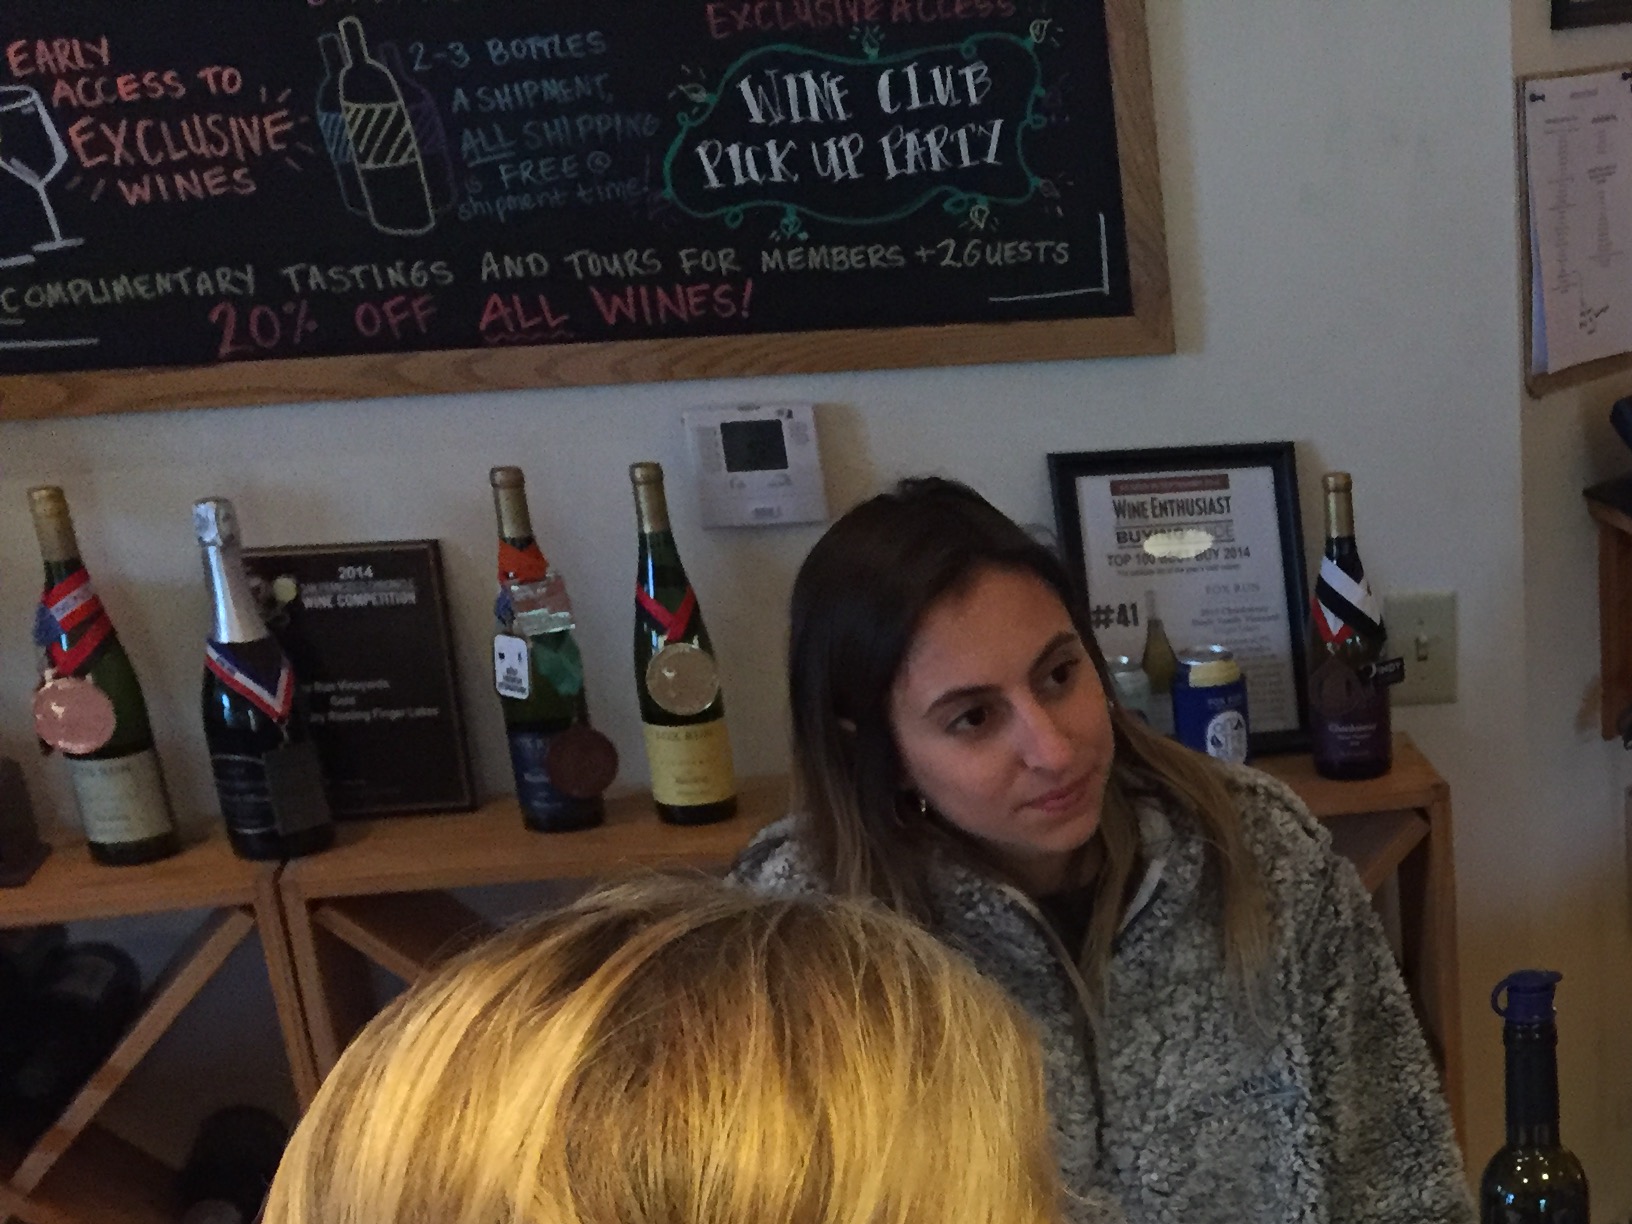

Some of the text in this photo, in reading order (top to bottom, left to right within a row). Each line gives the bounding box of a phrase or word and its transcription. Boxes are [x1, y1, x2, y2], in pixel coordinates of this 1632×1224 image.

[5, 34, 110, 78] EARLY
[408, 30, 608, 72] 2-3 BOTTLES
[52, 64, 243, 108] ACCESS TO
[735, 59, 993, 127] WINE CLUB
[67, 108, 295, 169] EXCLUSIVE
[460, 113, 661, 164] ALL SHIPPING
[693, 118, 1005, 190] PICK UP PARTY
[116, 166, 258, 207] WINES
[498, 153, 579, 190] FREE
[1, 263, 256, 314] COMPLIMENTARY
[280, 257, 456, 295] TASTINGS
[480, 250, 550, 283] AND
[564, 247, 663, 282] TOURS
[680, 246, 742, 279] FOR
[760, 242, 908, 273] MEMBERS
[208, 278, 754, 360] 20% OFF ALL WINES!
[1112, 495, 1232, 520] WINE ENTHUSIAST
[337, 565, 374, 579] 2014
[1107, 554, 1132, 567] TOP
[1223, 546, 1251, 560] 2014
[1090, 602, 1140, 629] #41
